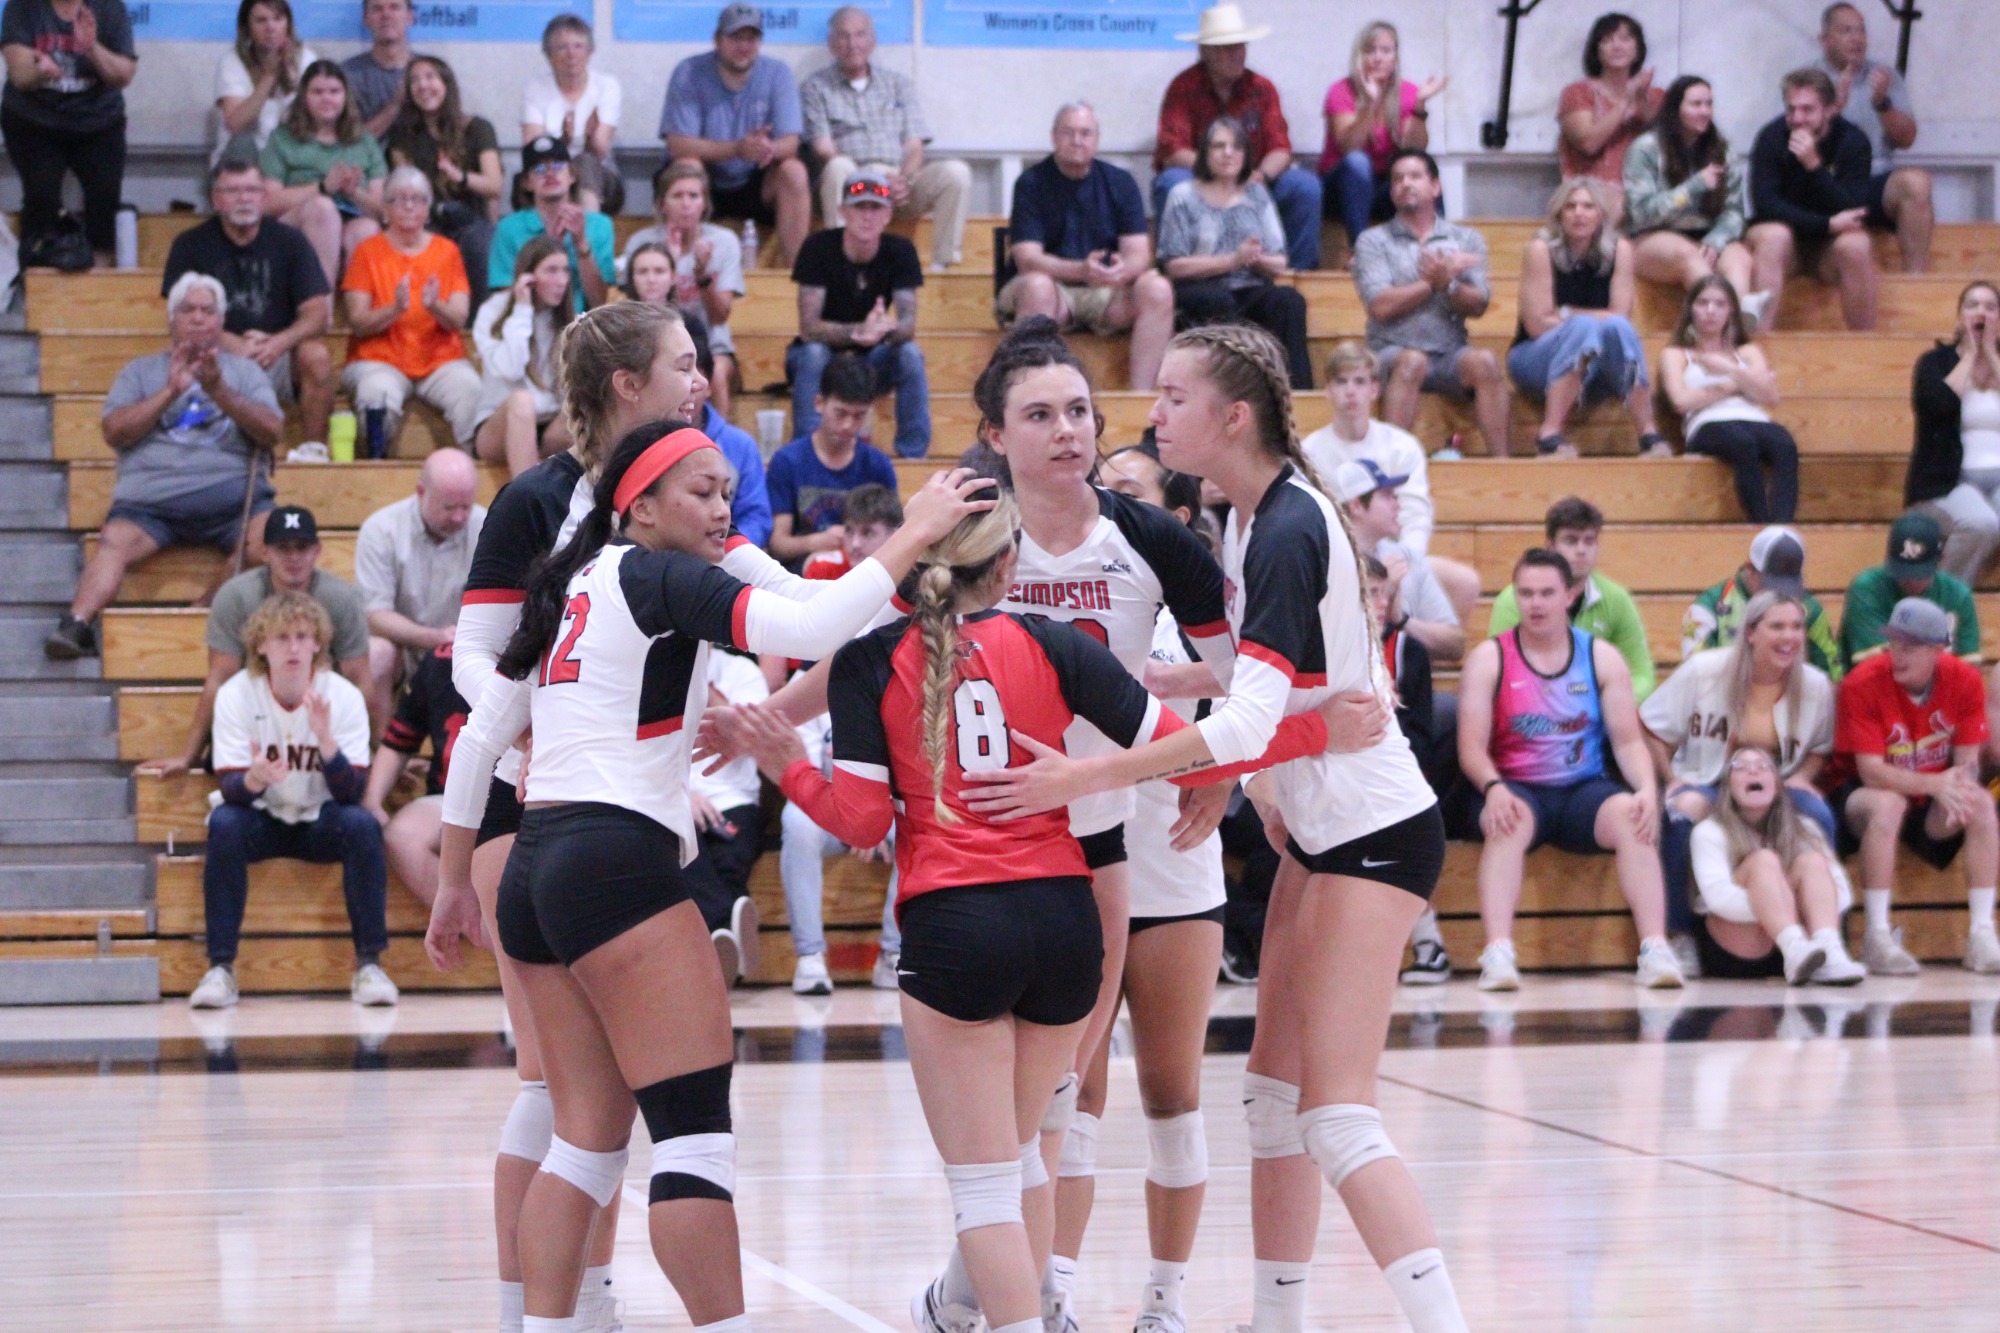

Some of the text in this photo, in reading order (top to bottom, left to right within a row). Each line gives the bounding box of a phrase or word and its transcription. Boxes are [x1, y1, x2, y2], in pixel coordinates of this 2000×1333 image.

[984, 12, 1157, 33] Women's Cross Country
[1007, 580, 1111, 610] SIMPSON
[953, 678, 1011, 773] 8
